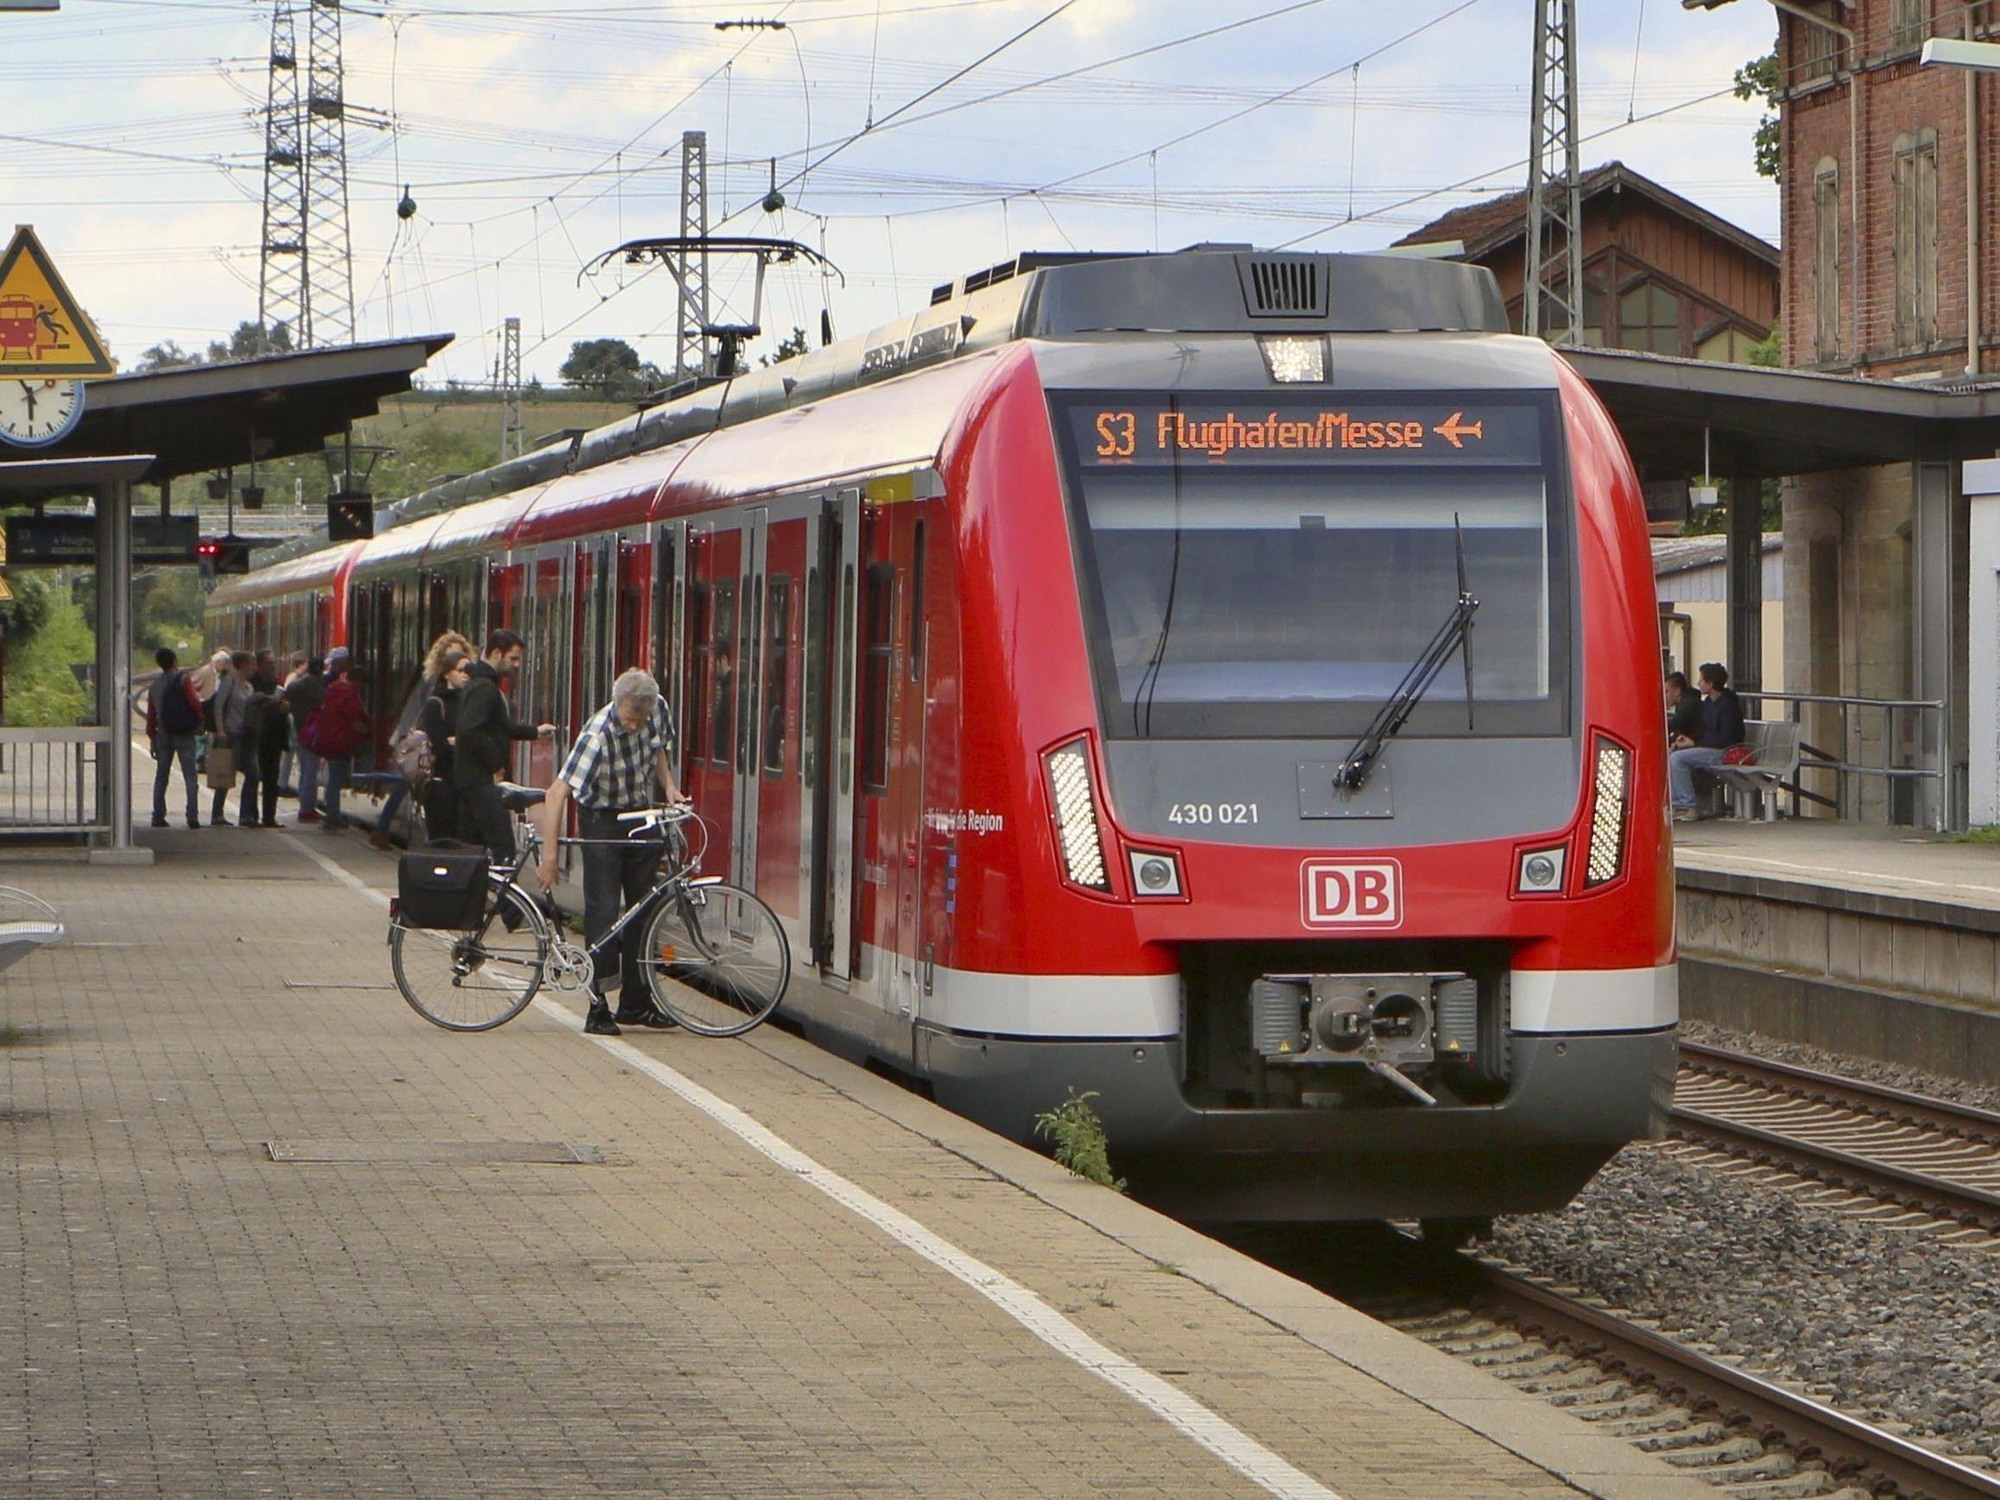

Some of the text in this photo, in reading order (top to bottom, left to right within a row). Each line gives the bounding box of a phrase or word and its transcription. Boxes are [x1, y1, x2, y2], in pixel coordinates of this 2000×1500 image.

[1096, 412, 1424, 456] S3 Flughafen/Messe
[968, 808, 1004, 836] Region
[1168, 803, 1259, 824] 430 021
[1314, 869, 1390, 917] DB
